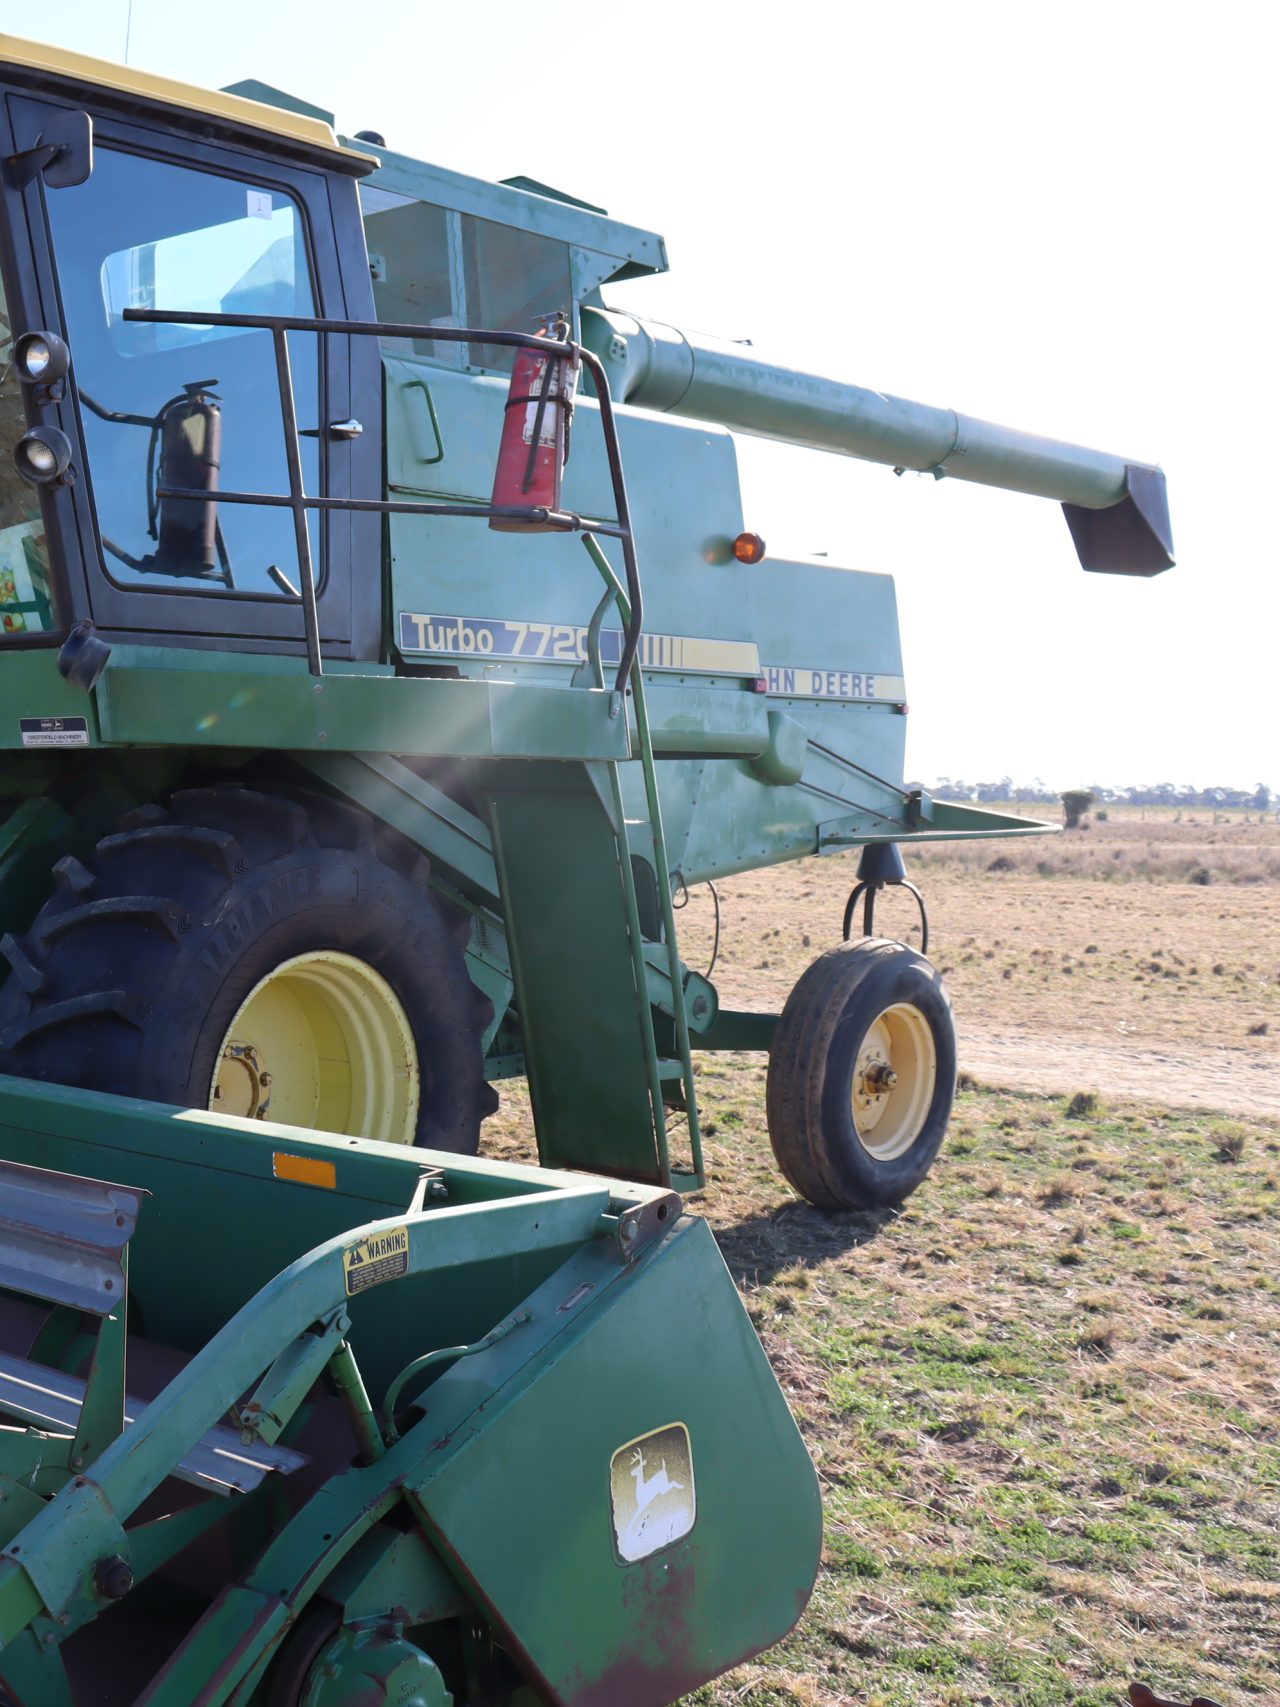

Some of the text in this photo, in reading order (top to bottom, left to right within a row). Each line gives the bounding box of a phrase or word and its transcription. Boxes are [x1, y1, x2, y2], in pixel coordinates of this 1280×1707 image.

[411, 614, 494, 653] Turbo
[768, 668, 875, 698] HN DEERE
[366, 1233, 406, 1260] WARNING
